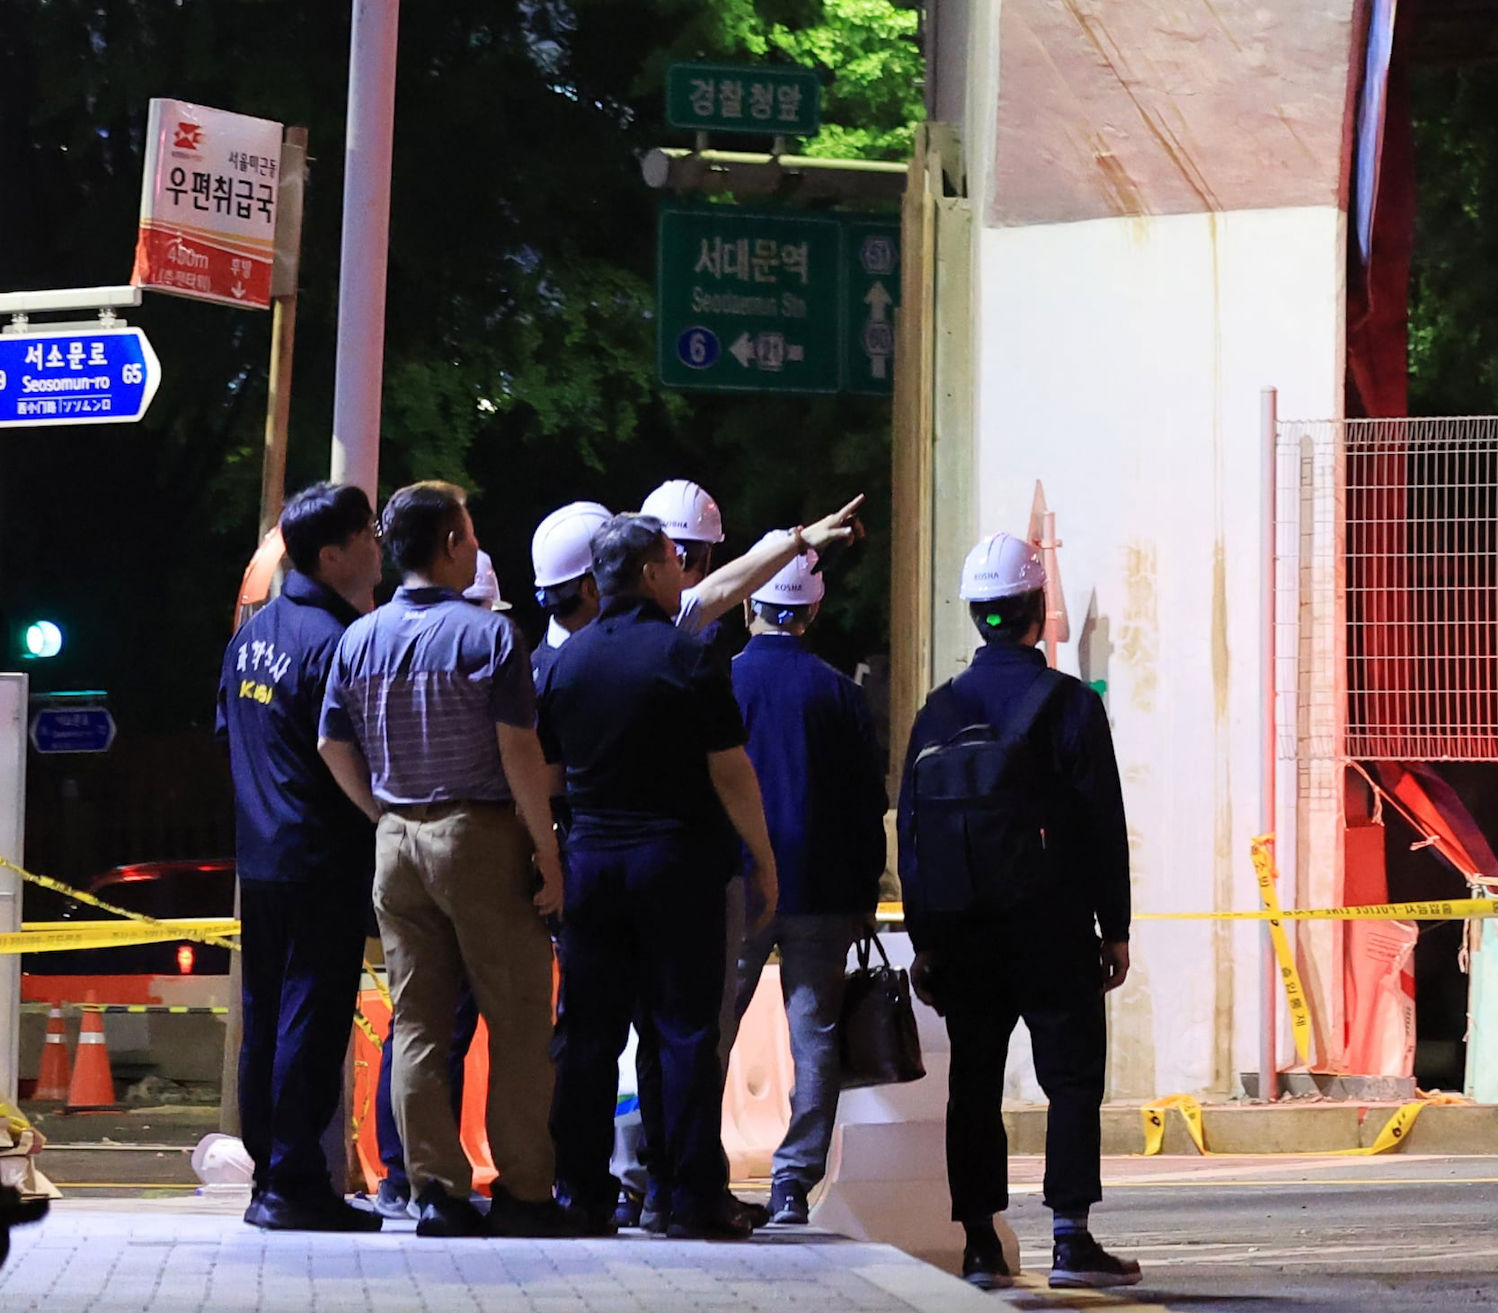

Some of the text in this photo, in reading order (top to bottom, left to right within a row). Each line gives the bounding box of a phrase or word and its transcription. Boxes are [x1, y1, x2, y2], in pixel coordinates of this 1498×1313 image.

[165, 166, 275, 223] 우편취급국
[694, 236, 810, 285] 서대문역
[24, 341, 108, 371] 서소문로
[690, 332, 707, 364] 6
[22, 375, 110, 393] Seosomun-ro
[122, 363, 143, 384] 65
